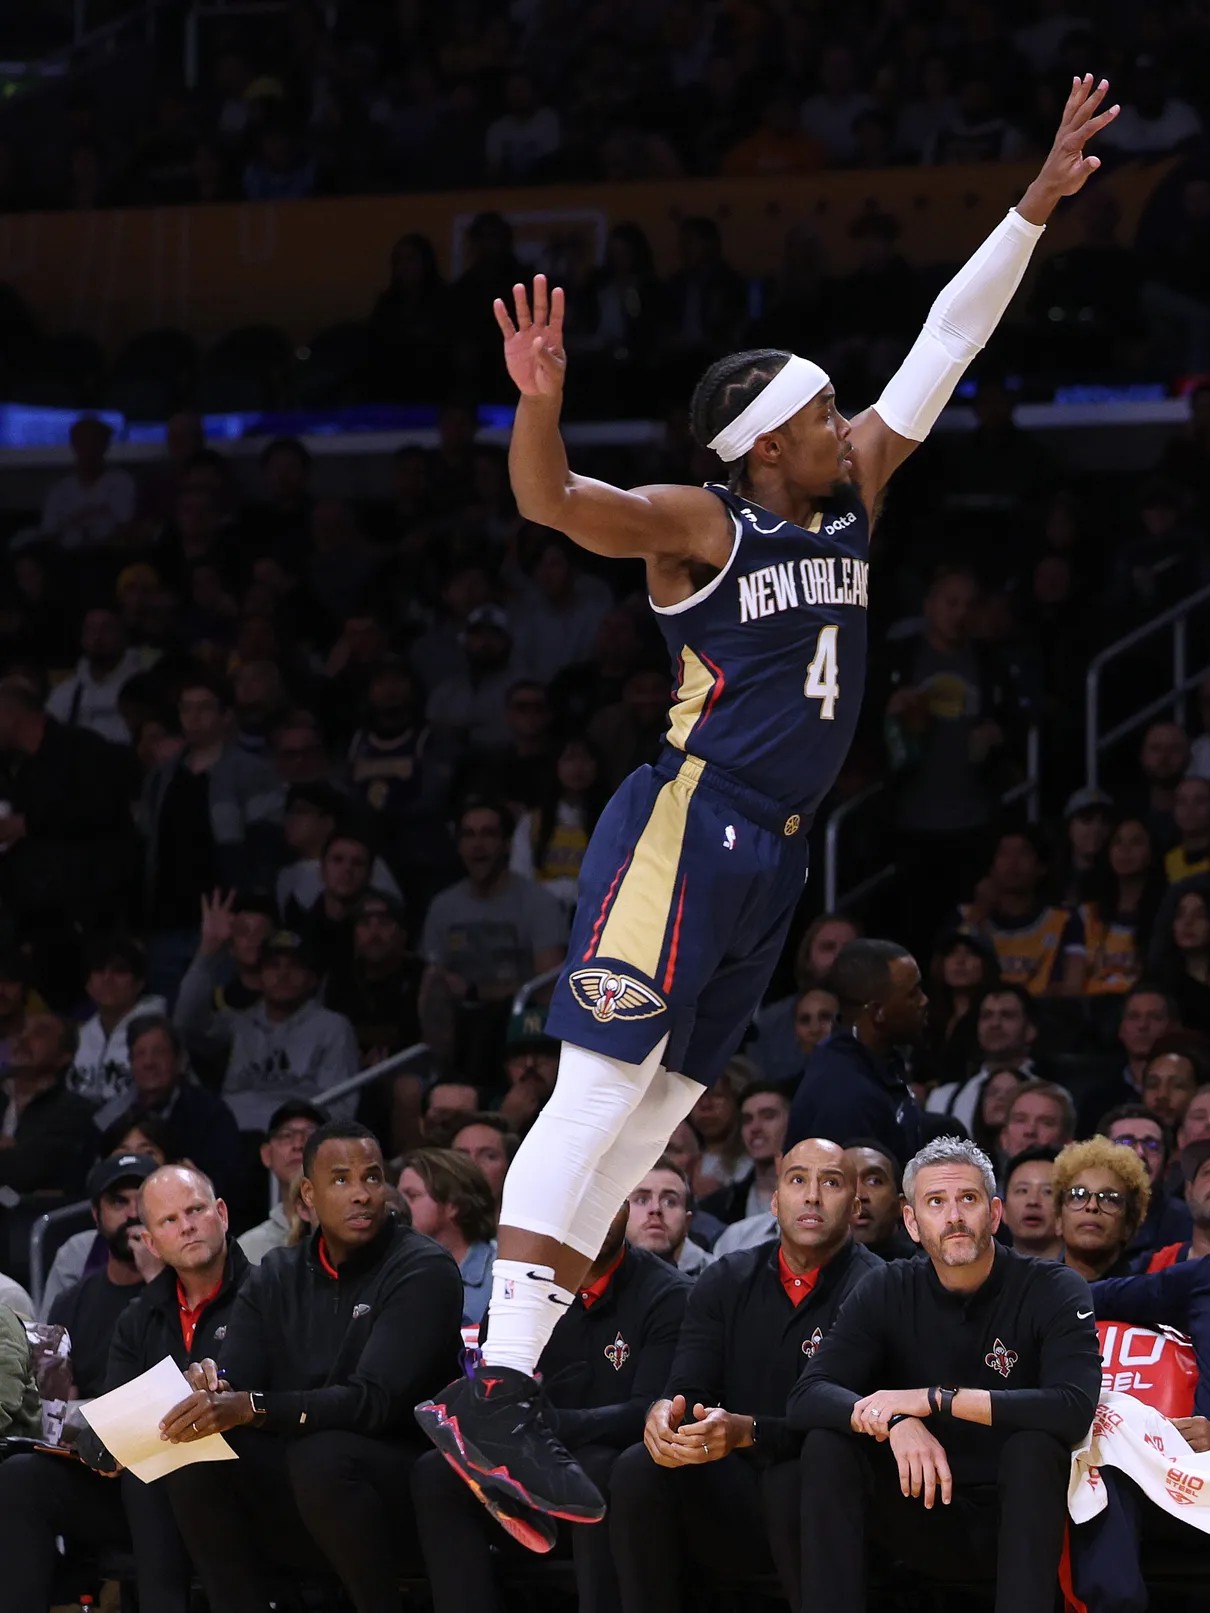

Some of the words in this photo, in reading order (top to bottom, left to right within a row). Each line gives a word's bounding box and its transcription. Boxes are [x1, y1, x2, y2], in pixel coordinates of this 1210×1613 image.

[738, 560, 799, 623] NEW
[800, 557, 869, 610] ORLEAN
[804, 625, 839, 720] 4
[1101, 1326, 1166, 1367] IO
[1101, 1371, 1153, 1391] EEL
[1166, 1478, 1198, 1498] STEEL
[1167, 1468, 1204, 1490] BIO
